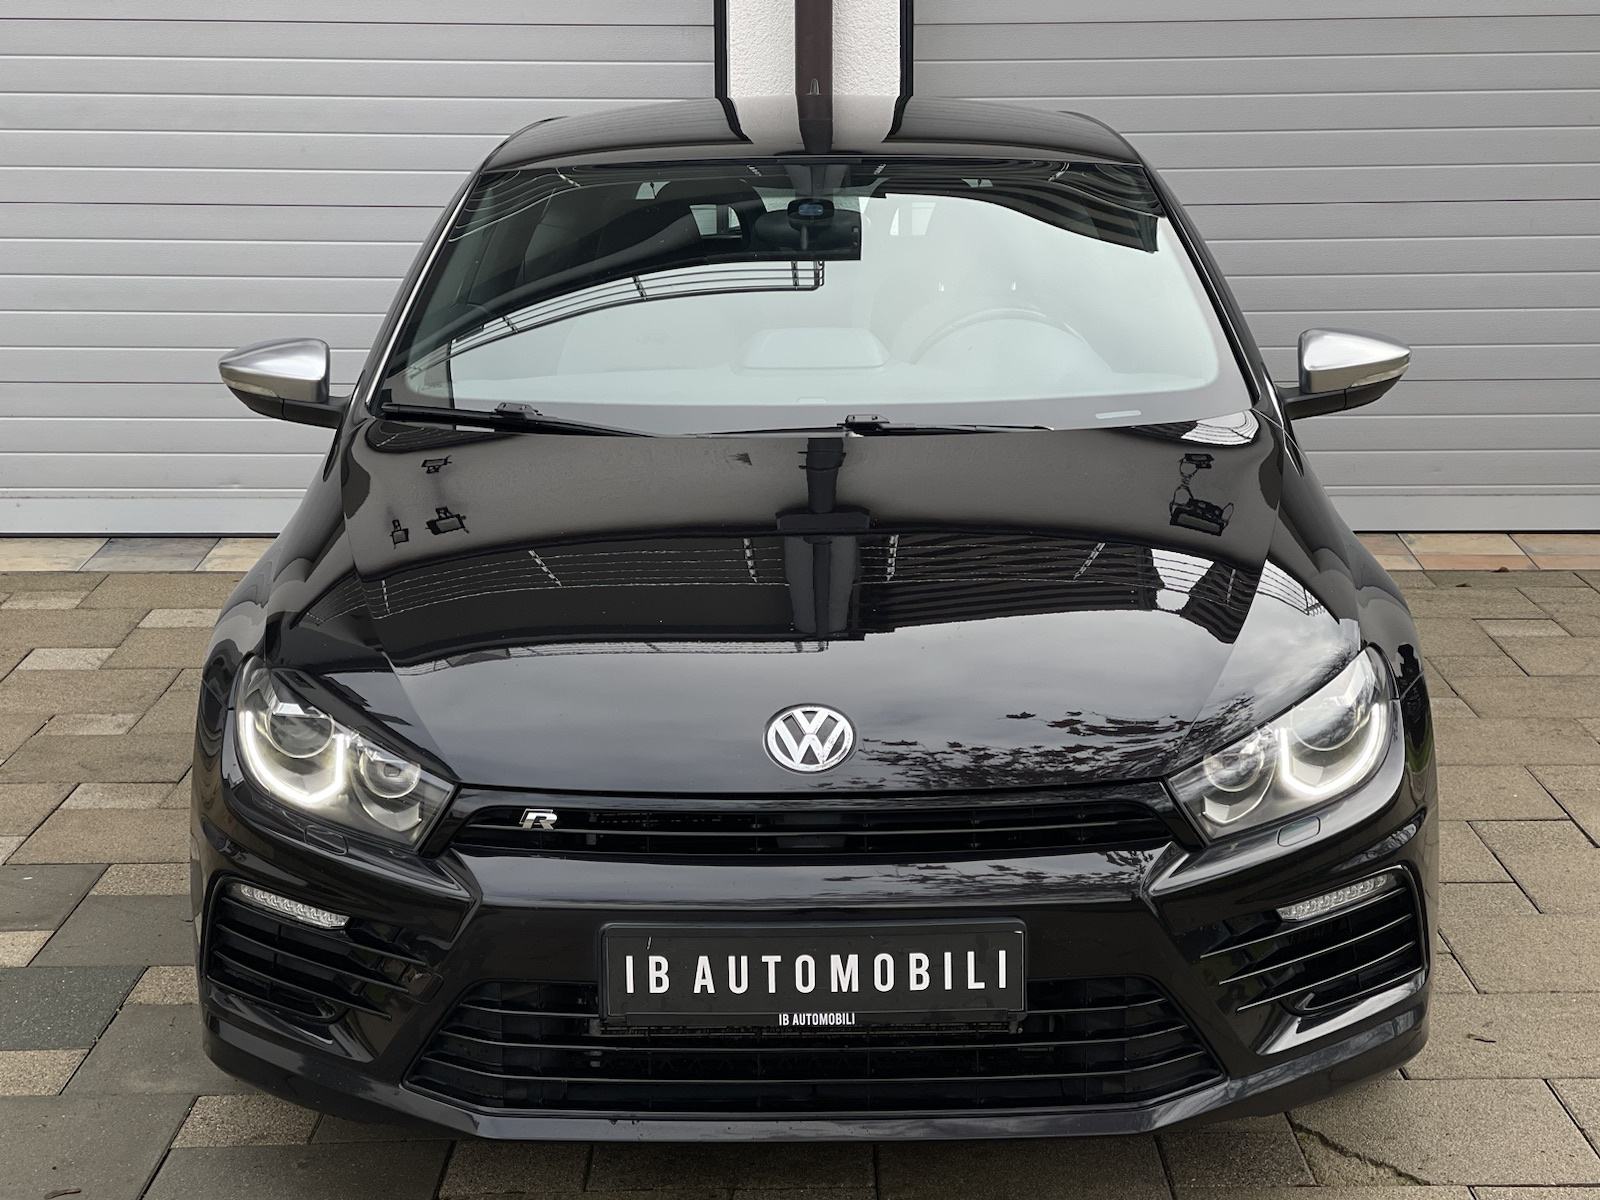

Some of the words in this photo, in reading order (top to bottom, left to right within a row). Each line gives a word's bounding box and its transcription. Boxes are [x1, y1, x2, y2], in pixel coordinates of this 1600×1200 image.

[766, 705, 854, 772] VW
[520, 808, 558, 830] R
[625, 954, 670, 994] IB
[693, 949, 1008, 995] AUTOMOBILI
[778, 1012, 790, 1026] IB
[791, 1011, 856, 1026] AUTOMOBILI
